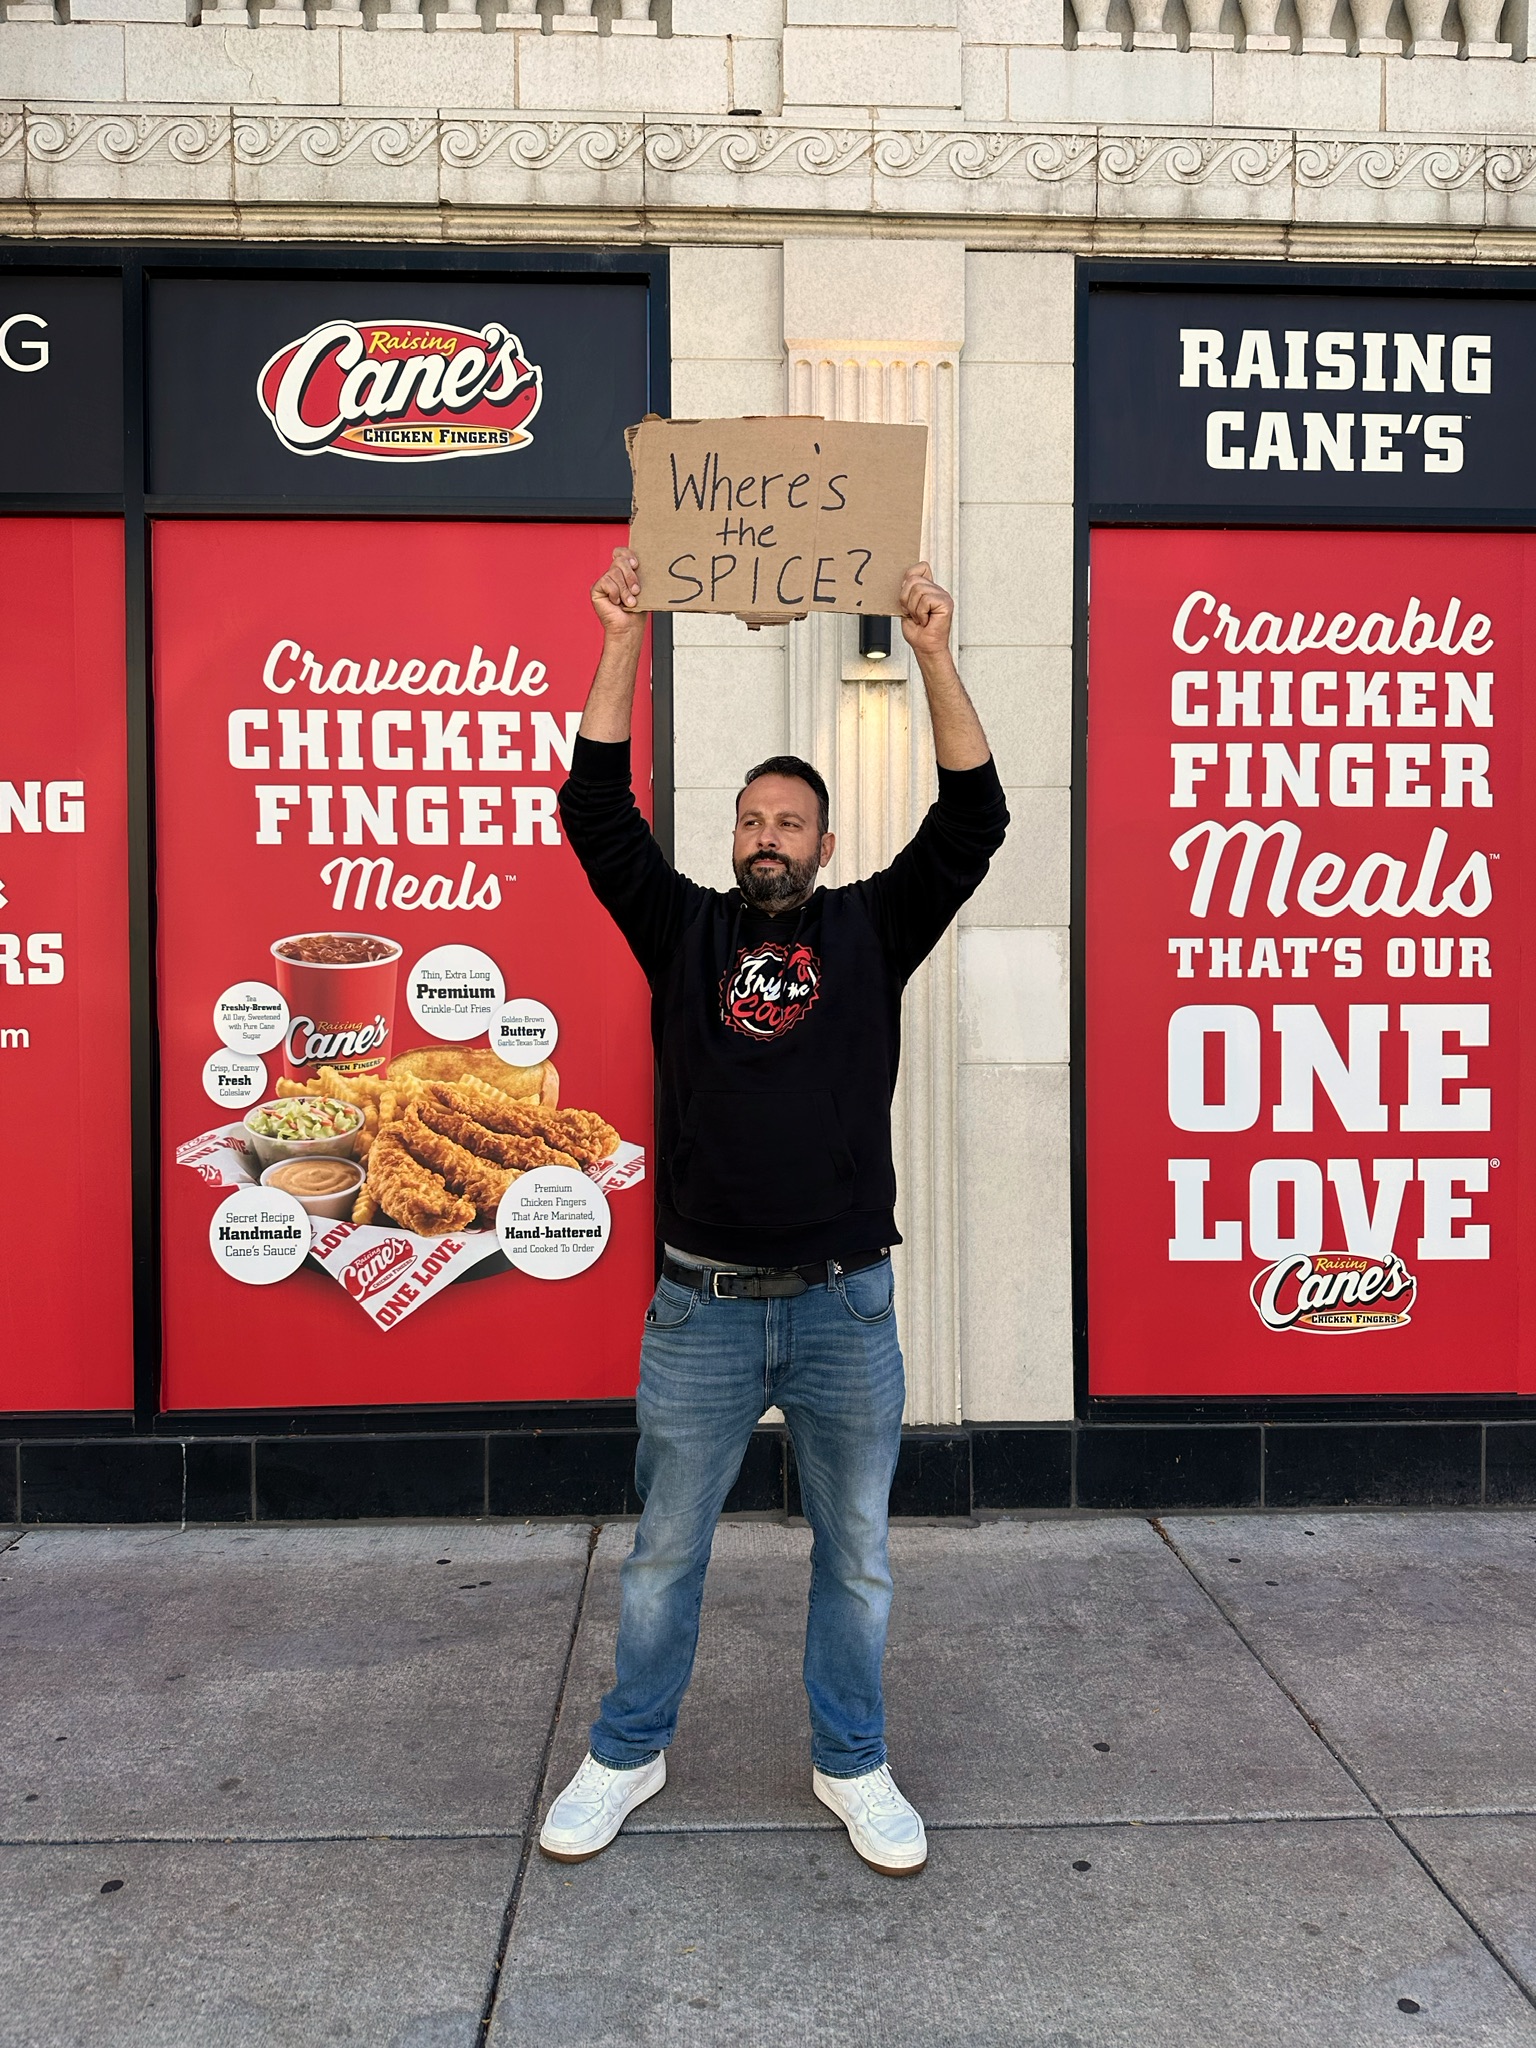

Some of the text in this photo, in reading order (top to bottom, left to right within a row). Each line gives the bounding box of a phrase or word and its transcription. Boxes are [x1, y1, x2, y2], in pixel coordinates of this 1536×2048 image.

[369, 331, 457, 356] Raising
[1179, 328, 1492, 394] RAISING
[275, 323, 536, 444] Cane's
[364, 428, 509, 444] CHICKEN FINGERS
[1206, 410, 1464, 473] CANE'S
[670, 443, 848, 512] Where's
[716, 517, 777, 547] the
[668, 549, 872, 606] SPICE?
[1172, 590, 1494, 656] Craveable
[262, 639, 549, 696] Craveable
[1171, 670, 1494, 728] CHICKEN
[228, 708, 584, 771] CHICKEN
[1170, 743, 1494, 808] FINGER
[255, 784, 562, 845] FINGER
[1169, 820, 1493, 918] Meals
[319, 856, 502, 911] Meals
[1168, 937, 1493, 978] THAT'S OUR
[421, 970, 490, 981] Thin, Extra Long
[246, 995, 257, 1003] Tea
[416, 984, 495, 999] Premium
[788, 982, 810, 1000] the
[221, 1003, 282, 1012] Freshly-Brewed
[421, 1004, 491, 1013] Crinkle-Cut Fries
[222, 1013, 231, 1021] All
[248, 1013, 281, 1021] Sweetened
[317, 1021, 363, 1032] Raising
[501, 1025, 546, 1039] Buttery
[242, 1032, 261, 1041] Sugar
[285, 1014, 390, 1066] Cane's
[210, 1064, 260, 1073] Crisp, Creamy
[1168, 1004, 1491, 1132] ONE
[218, 1074, 252, 1086] Fresh
[534, 1184, 572, 1193] Premium
[520, 1197, 586, 1208] Chicken Fingers
[1168, 1158, 1491, 1261] LOVE
[226, 1212, 295, 1224] Secret Recipe
[512, 1211, 595, 1222] That Are Marinated,
[219, 1226, 302, 1240] Handmade
[505, 1226, 602, 1239] Hand-battered
[225, 1244, 296, 1257] Cane's Sauce
[513, 1244, 595, 1253] and Cooked To Order
[338, 1238, 407, 1301] Cane's
[1315, 1258, 1368, 1271] Raising
[376, 1238, 461, 1327] ONE LOVE
[1260, 1253, 1412, 1325] Cane's
[1311, 1314, 1398, 1323] CHICKEN FINGERS
